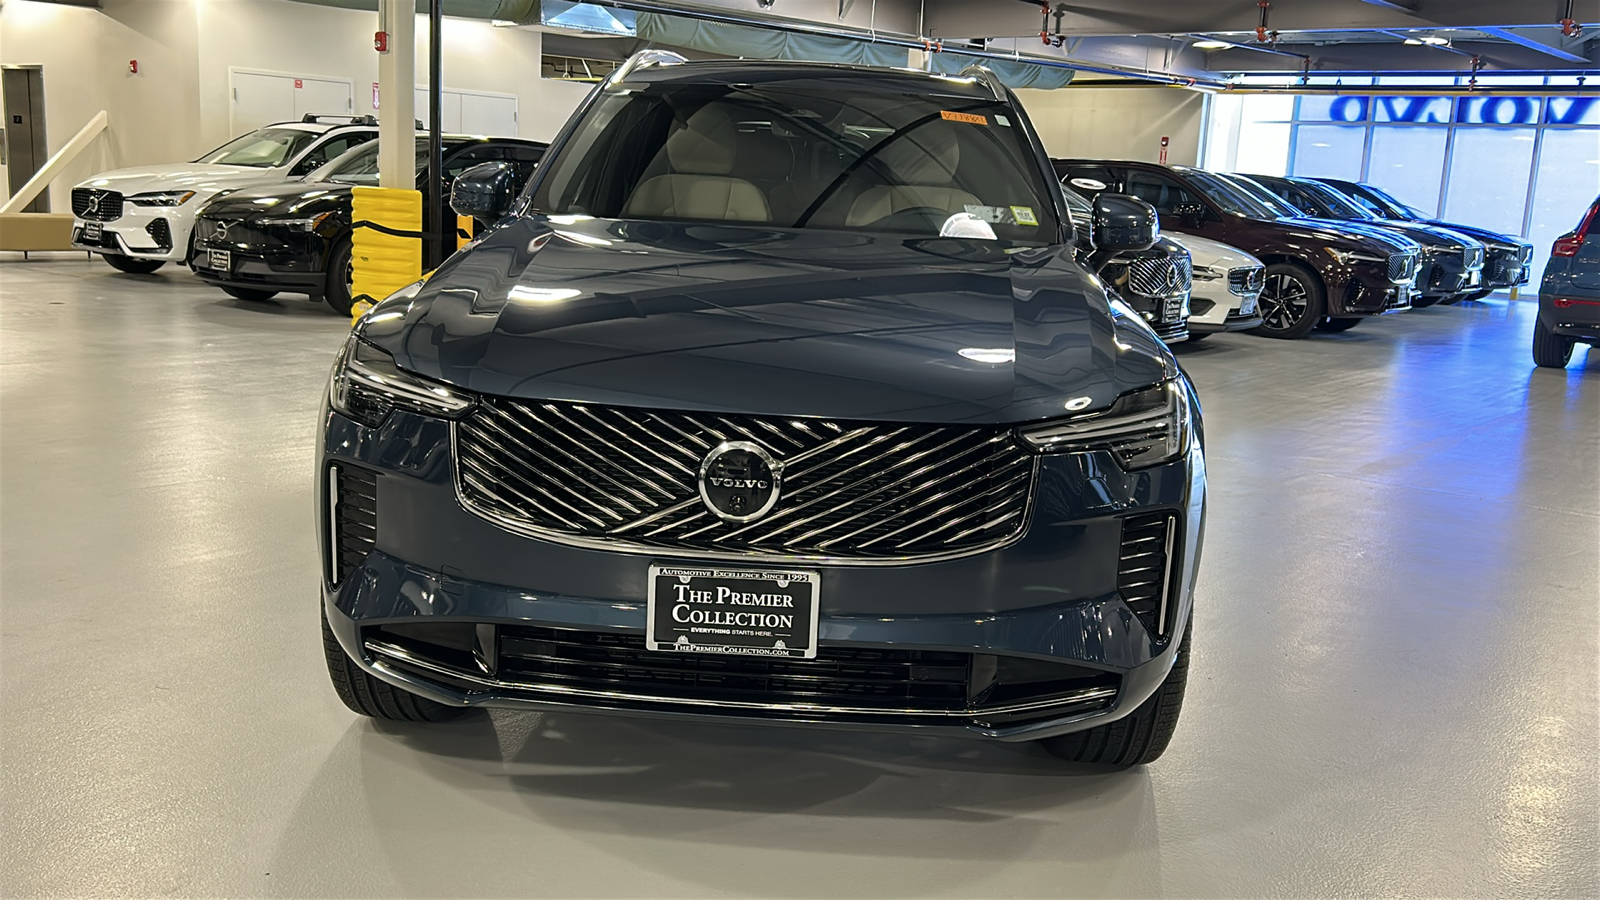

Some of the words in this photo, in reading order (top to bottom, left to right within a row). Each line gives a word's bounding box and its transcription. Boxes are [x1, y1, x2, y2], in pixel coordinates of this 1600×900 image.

[709, 476, 768, 489] VOLVO
[661, 568, 711, 576] AUTOMOTIVE
[713, 570, 760, 579] EXCELLENCE
[762, 572, 785, 580] SINCE
[787, 574, 808, 582] 1995
[673, 584, 713, 604] THE
[715, 586, 794, 608] PREMIER
[672, 603, 794, 628] COLLECTION
[690, 627, 731, 635] EVERYTHING
[673, 643, 789, 655] THEPREMIERCOLLECTION.COM
